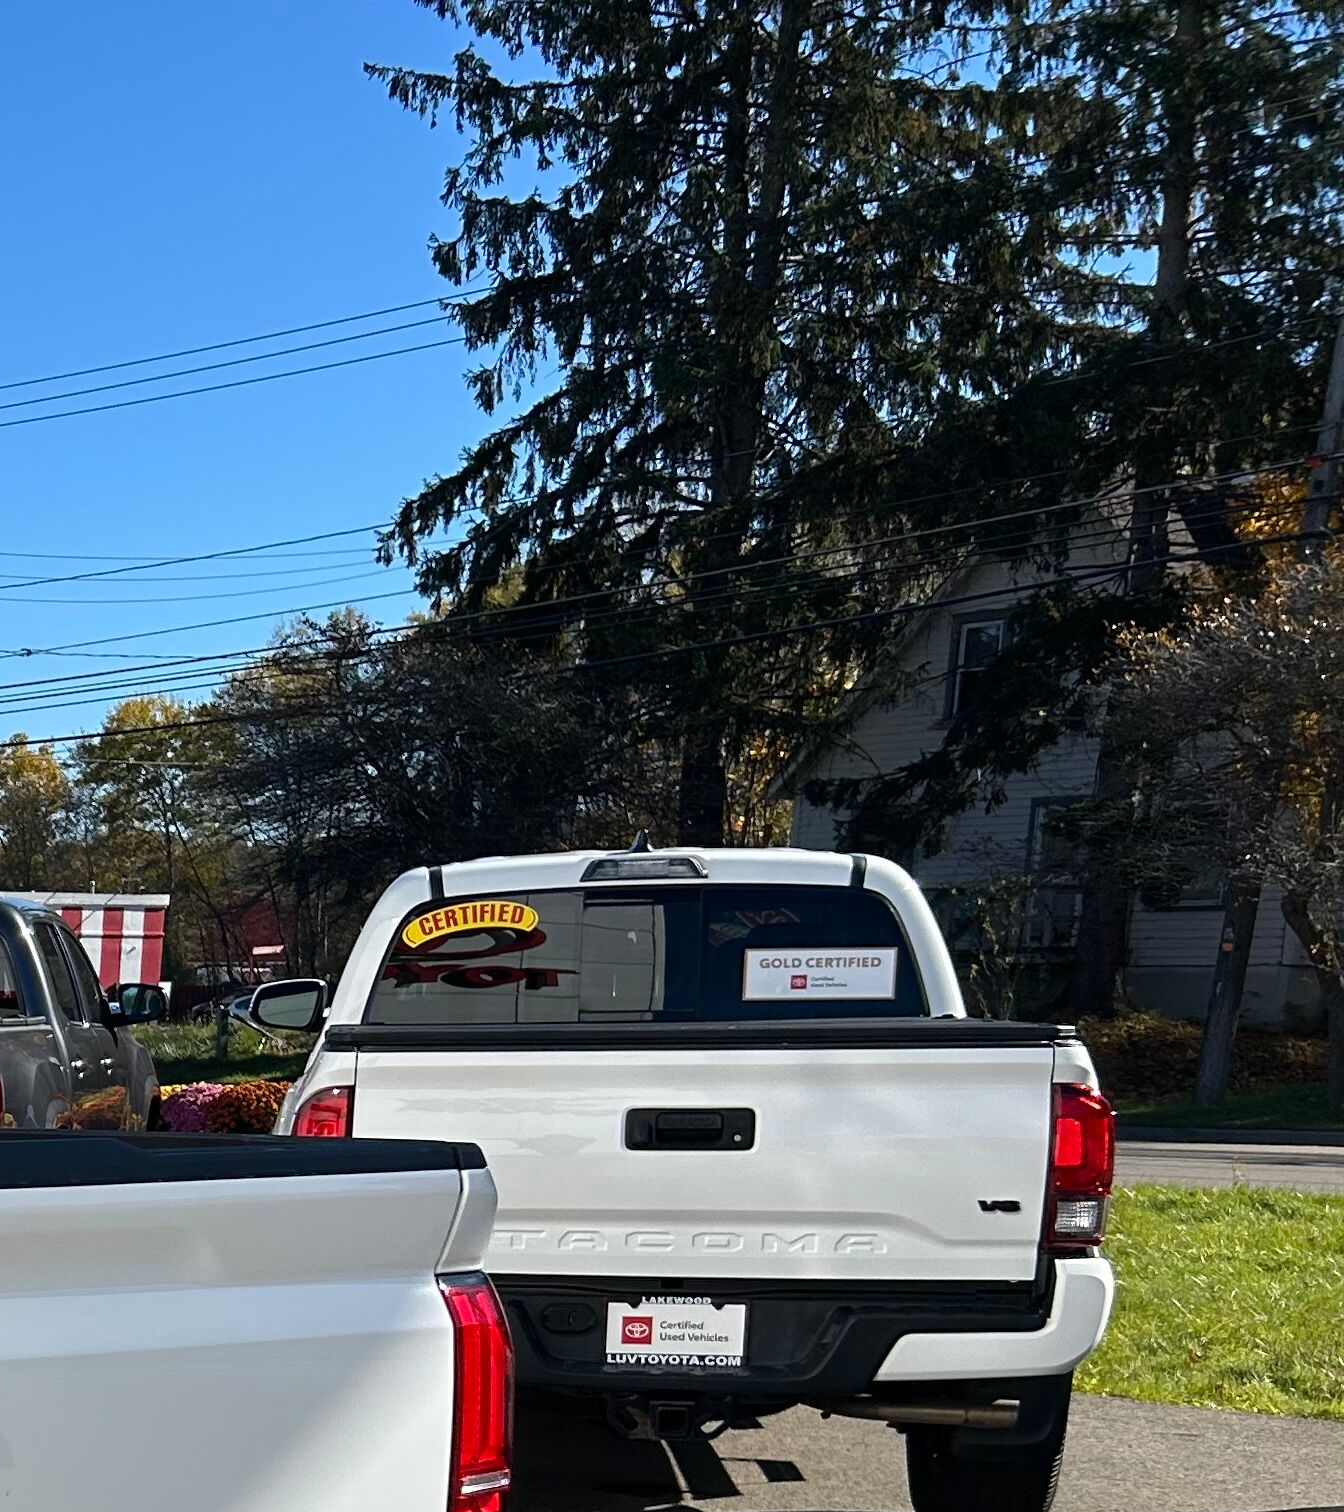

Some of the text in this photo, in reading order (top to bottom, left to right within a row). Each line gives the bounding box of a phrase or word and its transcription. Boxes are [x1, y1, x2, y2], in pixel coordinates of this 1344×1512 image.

[418, 903, 525, 936] CERTIFIED
[759, 957, 882, 968] GOLD CERTIFIED
[495, 1228, 889, 1255] TACOMA
[641, 1296, 712, 1305] LAKEWOOD
[659, 1320, 705, 1330] Certified
[659, 1332, 729, 1342] Used Vehicles
[606, 1354, 741, 1366] LUVTOYOTA.COM
